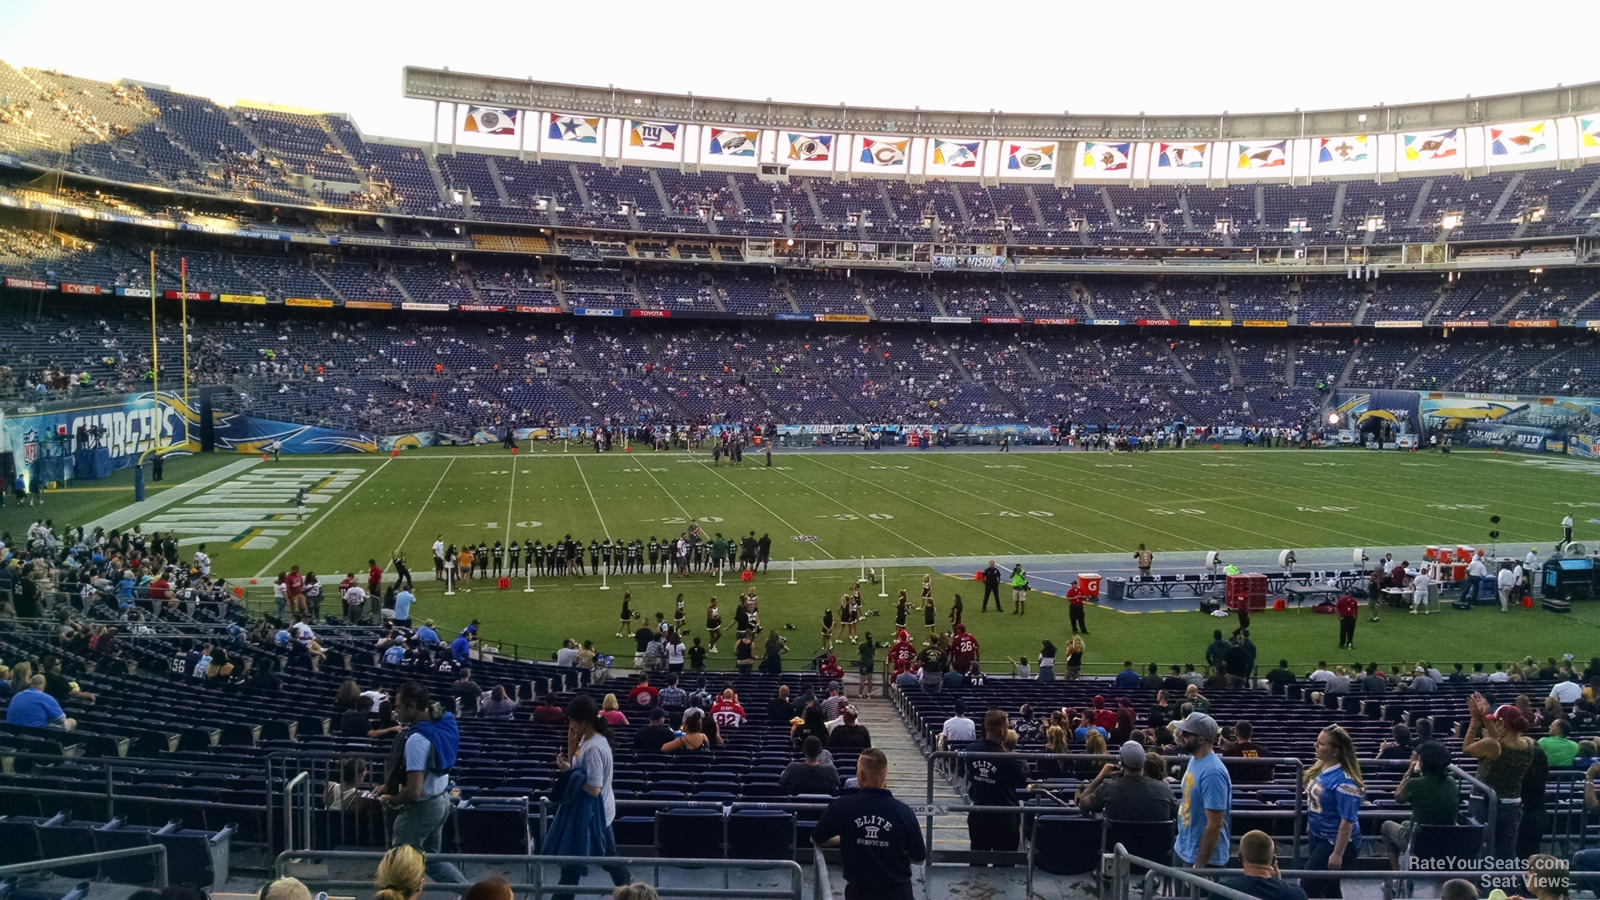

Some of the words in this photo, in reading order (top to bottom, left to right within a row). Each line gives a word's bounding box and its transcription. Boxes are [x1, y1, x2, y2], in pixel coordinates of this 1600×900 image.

[7, 279, 33, 287] TOSHIBA
[67, 284, 96, 294] CYMER
[124, 288, 151, 297] GEICO
[175, 291, 201, 300] TOYOTA
[585, 308, 614, 316] GEICO
[743, 572, 752, 581] 20
[499, 578, 509, 588] 10
[1088, 581, 1097, 591] G
[960, 641, 972, 652] 26
[898, 650, 909, 659] 26
[972, 760, 998, 774] ELITE
[973, 775, 997, 785] SERVICES
[854, 815, 893, 832] ELITE
[856, 838, 889, 848] SERVICES
